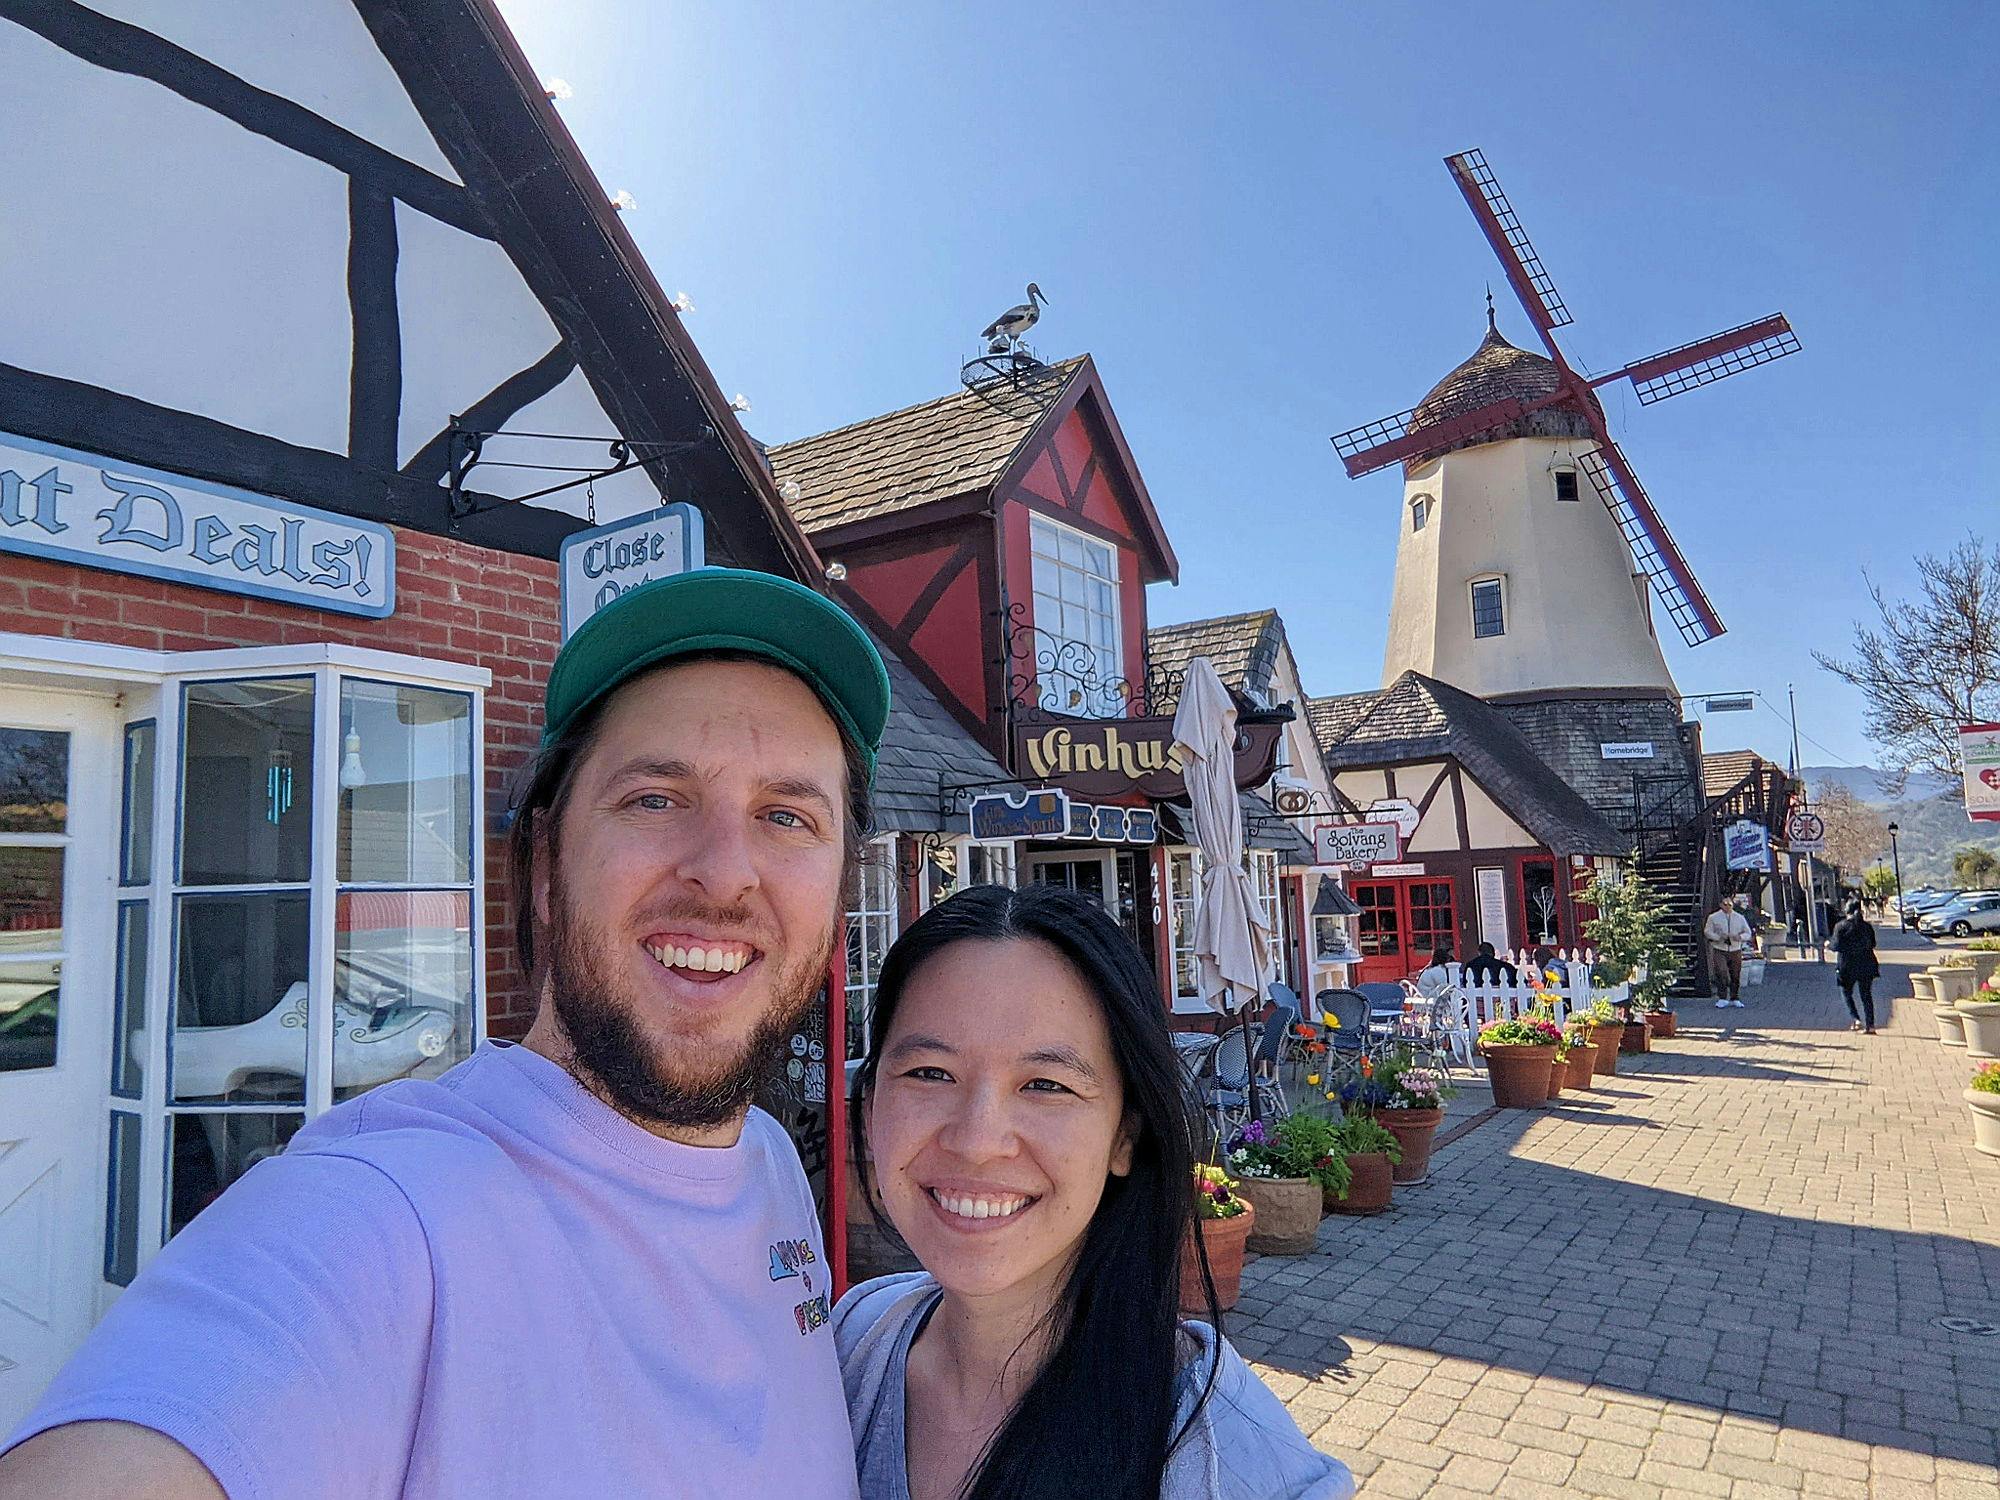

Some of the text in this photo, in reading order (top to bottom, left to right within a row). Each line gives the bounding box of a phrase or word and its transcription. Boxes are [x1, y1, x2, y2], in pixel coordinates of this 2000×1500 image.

[95, 469, 373, 598] Deals!
[583, 532, 665, 579] Close
[1604, 746, 1648, 755] Homebridge
[1327, 829, 1387, 850] Solvang
[1350, 827, 1364, 835] The
[1335, 846, 1379, 861] Bakery
[1150, 862, 1161, 926] 440
